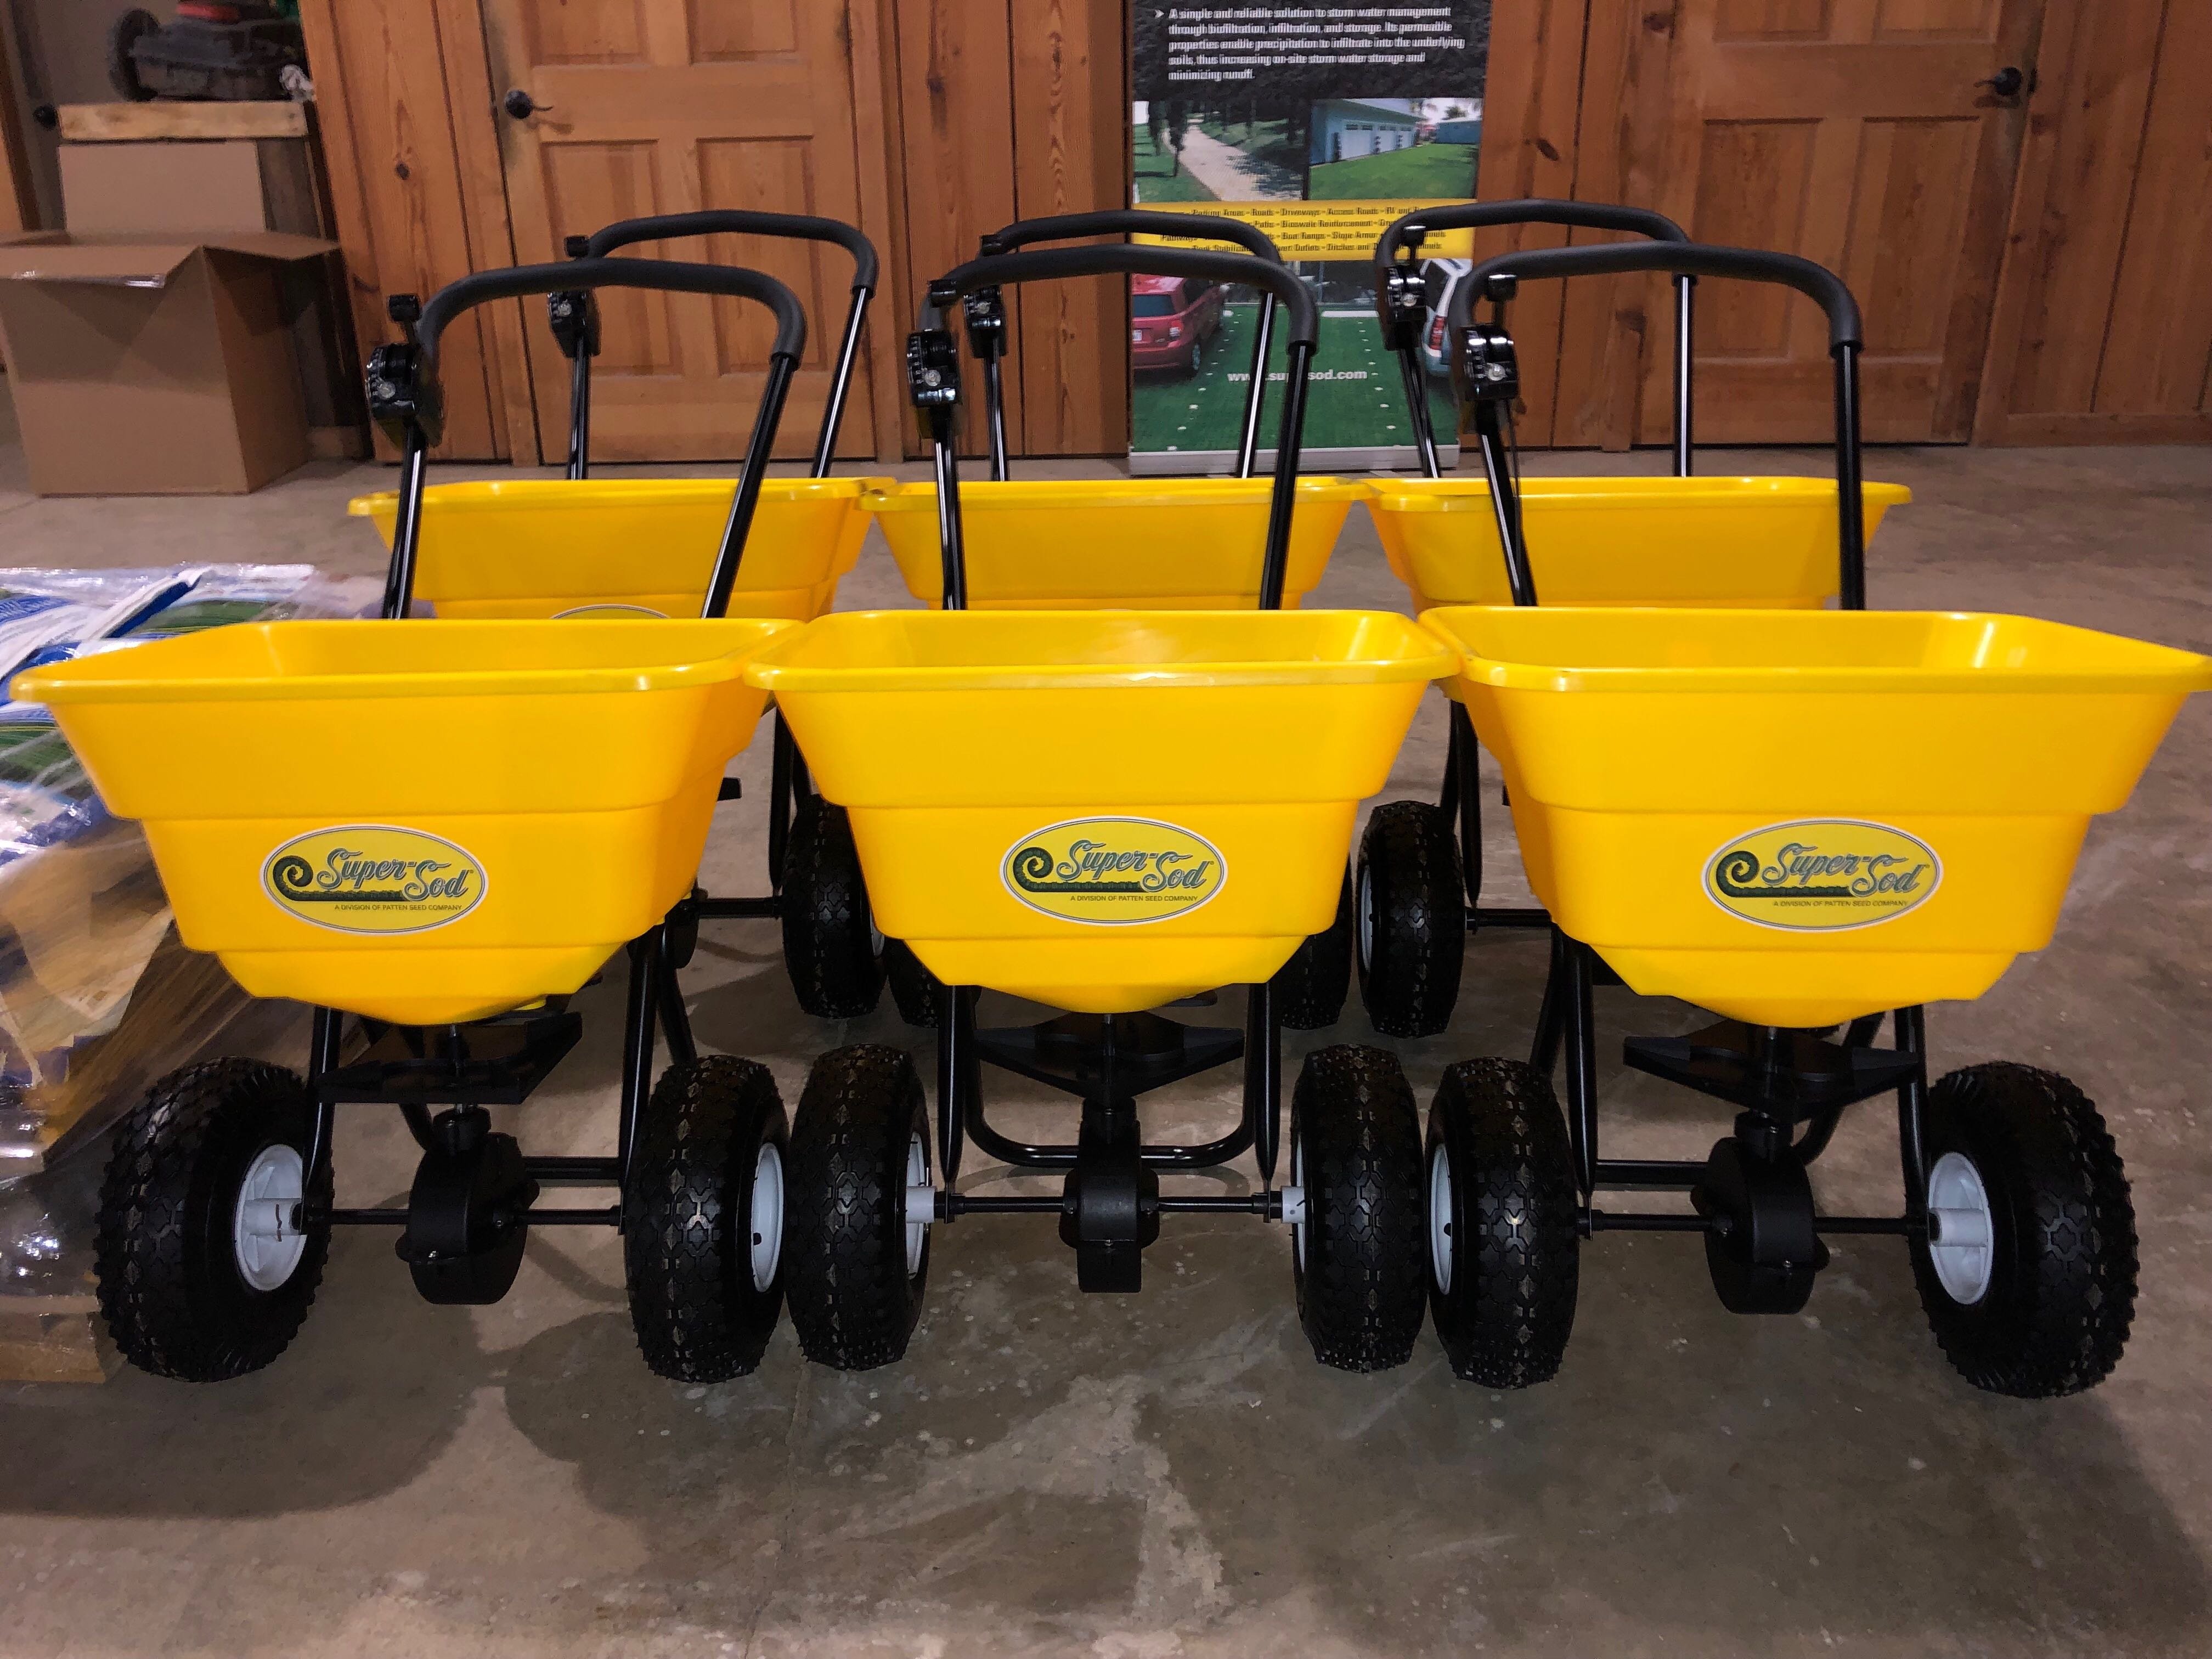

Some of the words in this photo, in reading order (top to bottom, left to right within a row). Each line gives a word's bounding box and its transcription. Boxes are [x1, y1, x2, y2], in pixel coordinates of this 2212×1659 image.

[1169, 8, 1178, 19] A
[1179, 8, 1213, 21] simple
[1214, 8, 1233, 18] and
[1234, 7, 1273, 18] reliable
[1274, 7, 1314, 18] solution
[1315, 8, 1327, 17] to
[1327, 8, 1356, 17] storm
[1356, 7, 1386, 17] water
[1387, 6, 1451, 19] management
[1169, 24, 1207, 37] through
[1207, 23, 1268, 34] biofiltration,
[1268, 22, 1323, 33] infiltration,
[1324, 22, 1344, 33] and
[1344, 22, 1384, 34] storage.
[1385, 21, 1398, 32] Its
[1399, 20, 1453, 35] permeable
[1169, 38, 1219, 53] properties
[1220, 38, 1254, 49] enable
[1255, 38, 1318, 51] precipitation
[1319, 38, 1330, 48] to
[1331, 37, 1373, 48] infiltrate
[1374, 37, 1393, 48] into
[1394, 36, 1411, 47] the
[1412, 36, 1465, 49] underlying
[1169, 54, 1196, 65] soils,
[1197, 54, 1218, 65] thus
[1219, 53, 1272, 66] increasing
[1272, 53, 1307, 64] on-site
[1308, 54, 1337, 64] storm
[1338, 53, 1367, 63] water
[1368, 54, 1405, 65] storage
[1406, 52, 1426, 63] and
[1169, 69, 1222, 82] minimizing
[1222, 68, 1256, 80] runoff.
